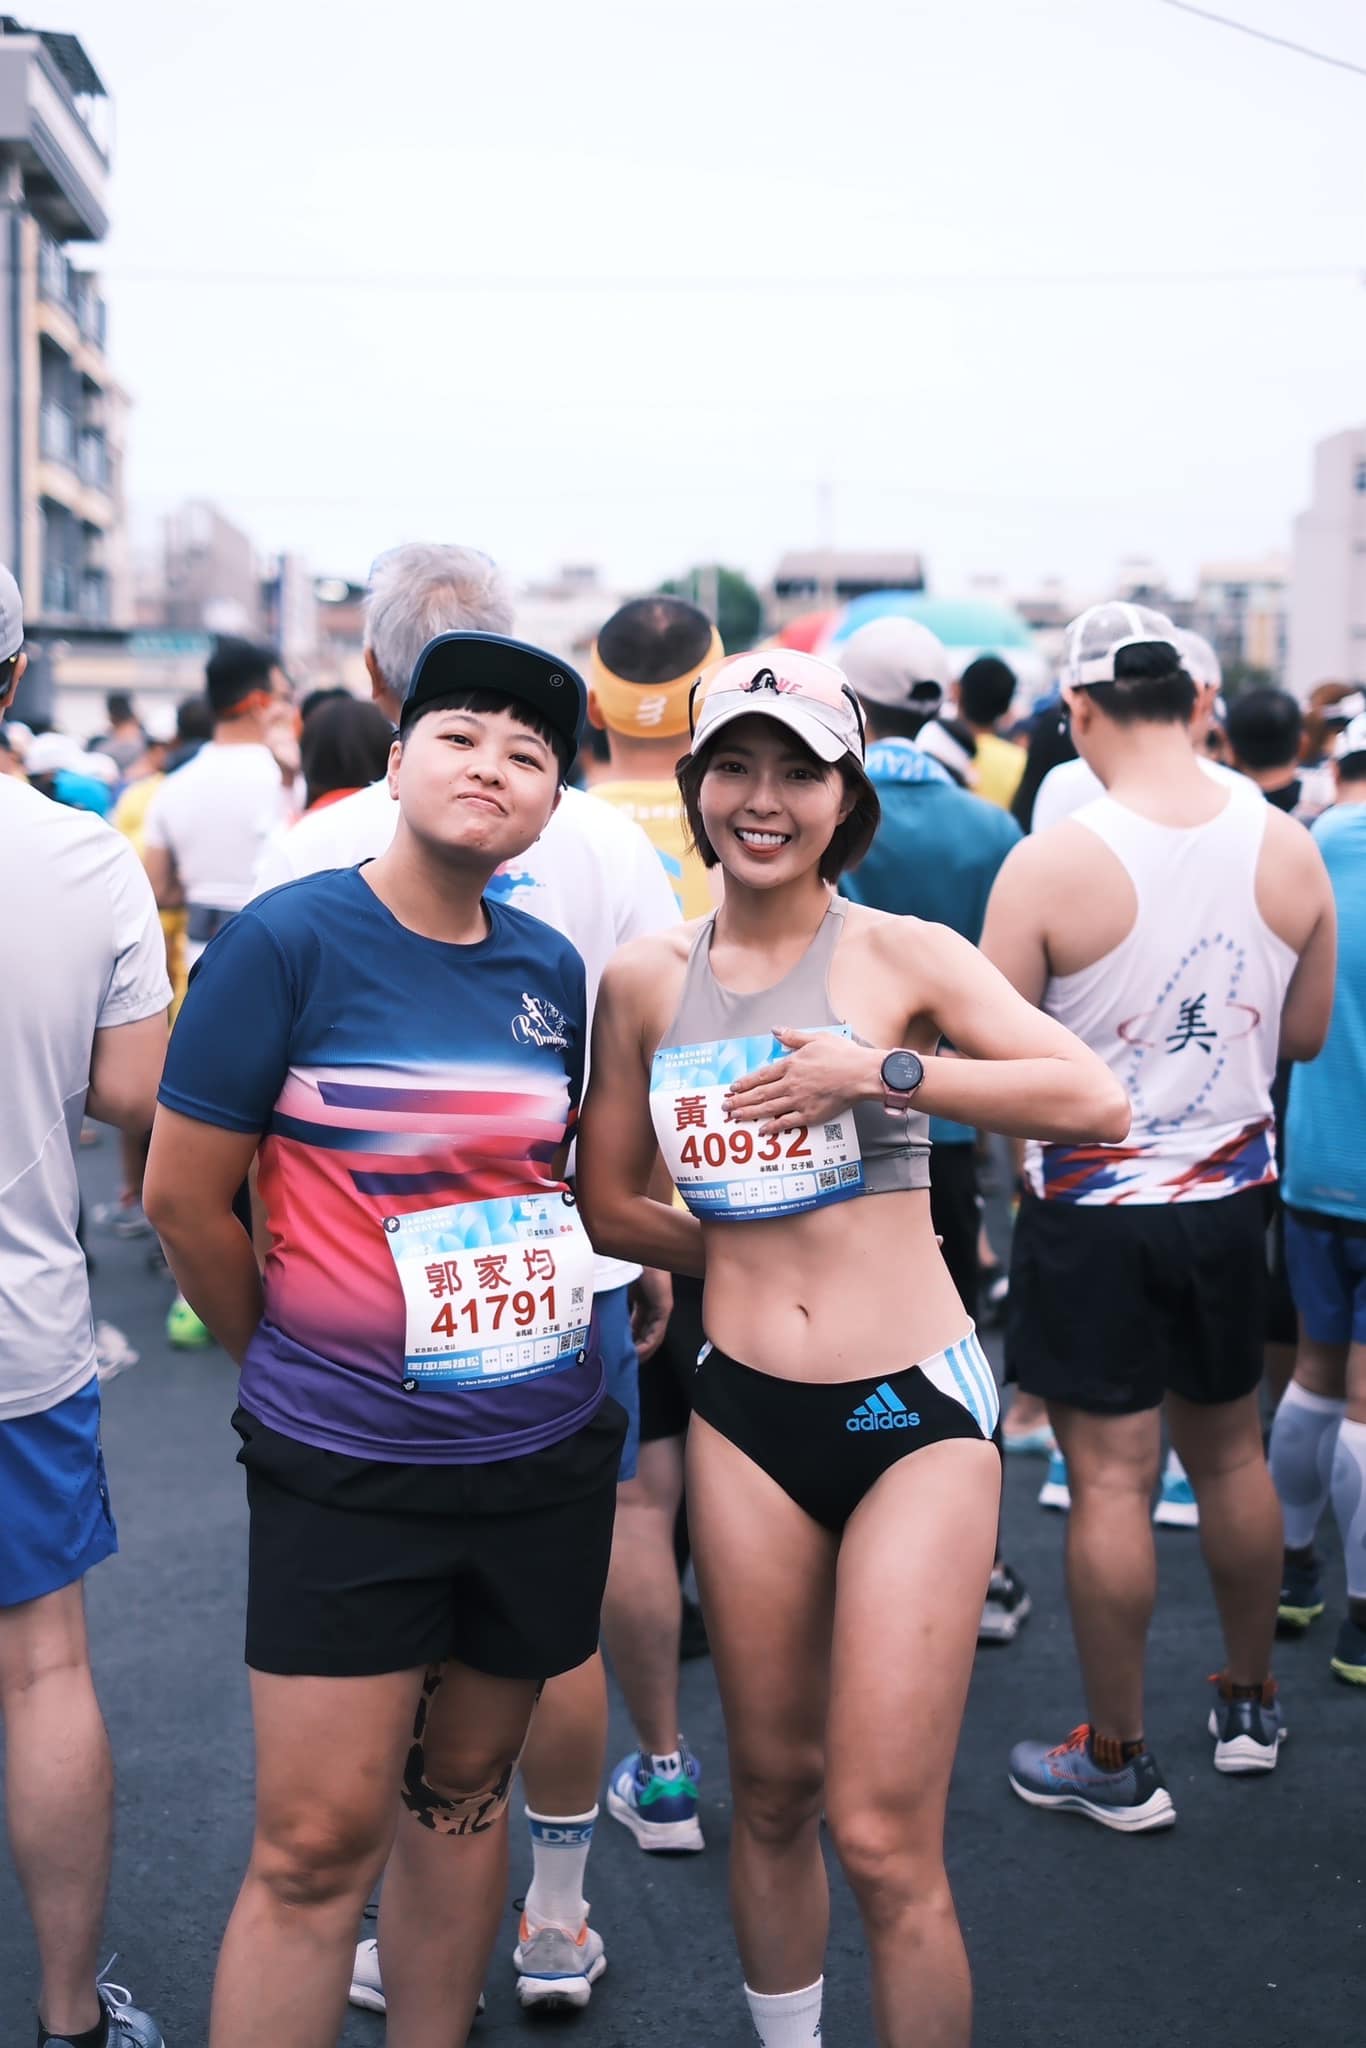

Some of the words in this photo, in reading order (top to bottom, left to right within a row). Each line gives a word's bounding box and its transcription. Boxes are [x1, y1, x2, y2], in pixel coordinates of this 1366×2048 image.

[1166, 992, 1217, 1054] 美
[680, 1125, 812, 1169] 40932
[424, 1248, 556, 1298] 郭家均
[431, 1286, 556, 1338] 41791
[846, 1411, 920, 1432] adidas
